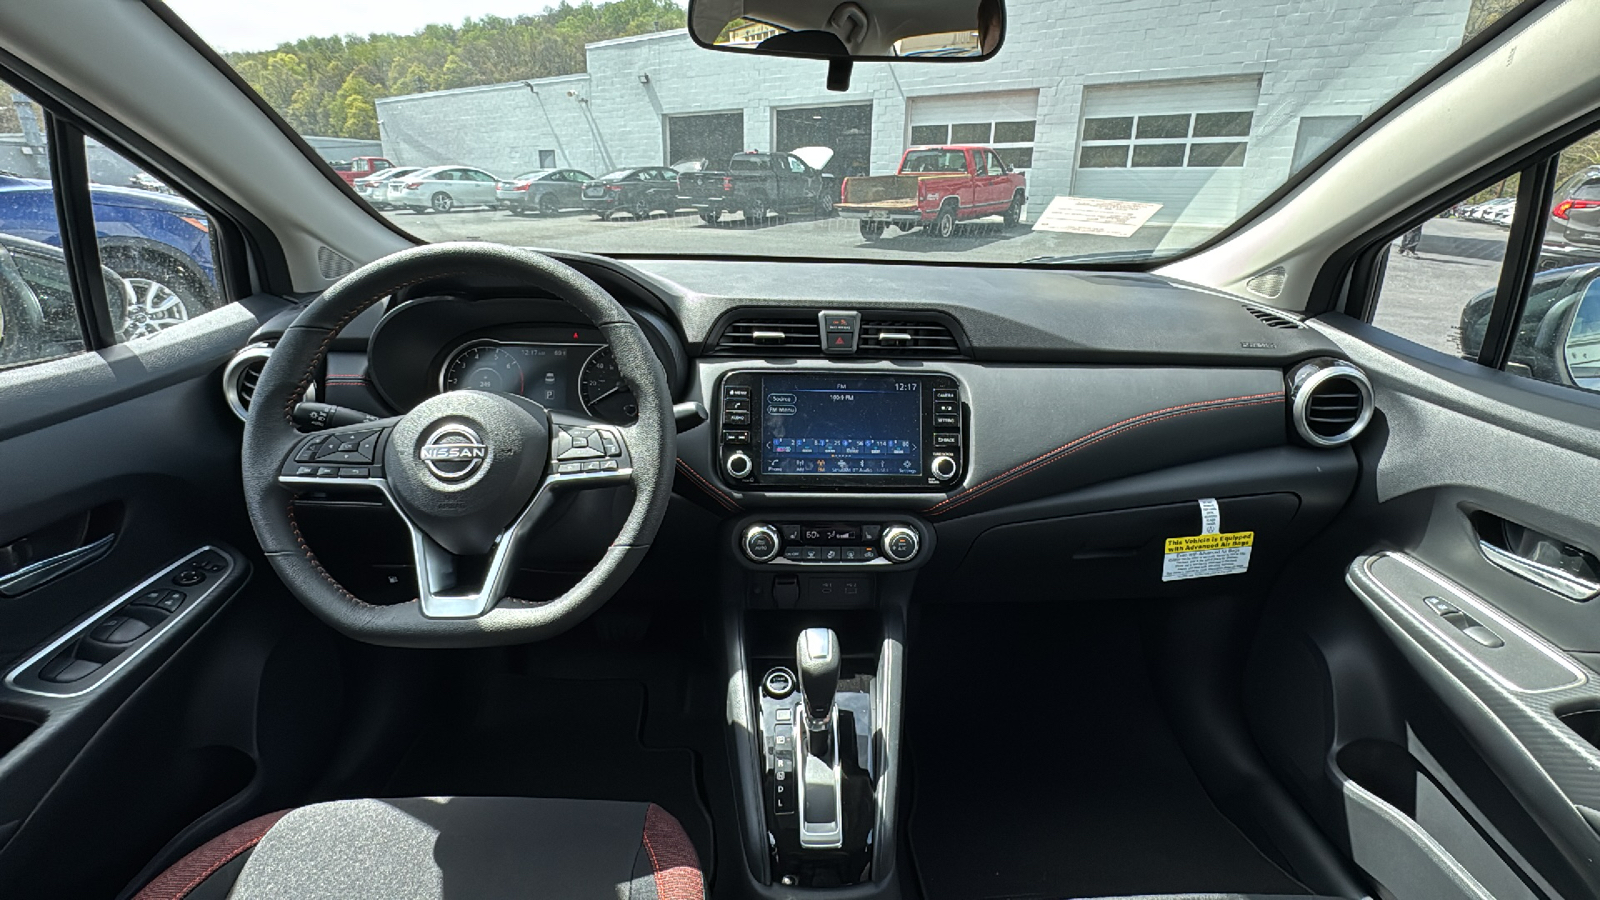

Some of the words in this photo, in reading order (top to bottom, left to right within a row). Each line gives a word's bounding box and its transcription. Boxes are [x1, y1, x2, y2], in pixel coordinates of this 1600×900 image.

[894, 383, 917, 391] 12:17
[421, 447, 485, 458] NISSAN
[1219, 533, 1252, 542] Equipped
[1184, 543, 1219, 551] Advanced
[777, 759, 784, 768] R
[777, 785, 784, 793] D
[777, 799, 783, 807] L
